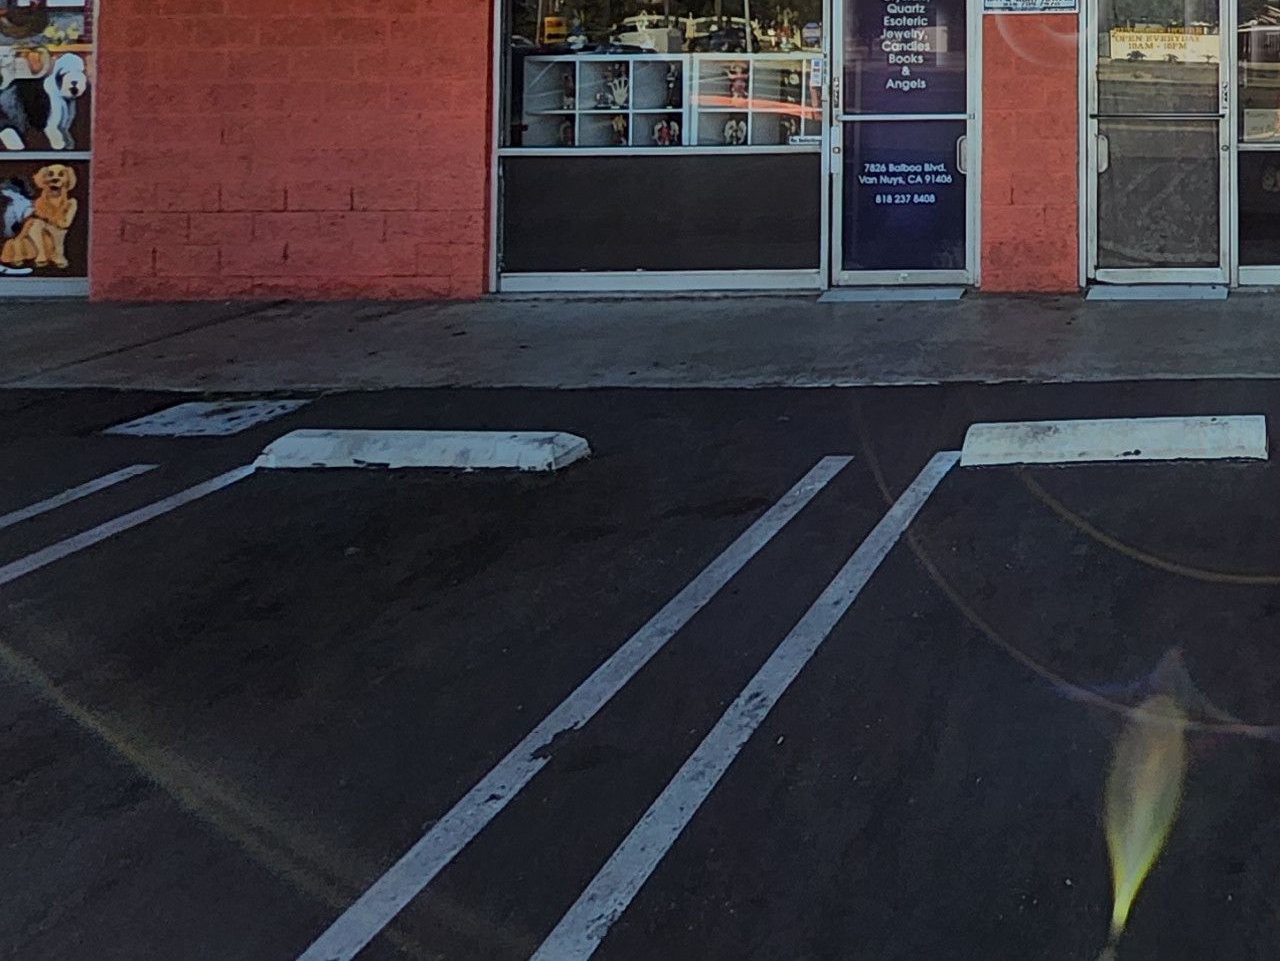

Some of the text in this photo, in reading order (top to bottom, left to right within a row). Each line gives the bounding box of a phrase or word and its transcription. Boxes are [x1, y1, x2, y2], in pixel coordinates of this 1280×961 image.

[886, 4, 925, 15] Quartz
[883, 16, 929, 26] Esoteric
[880, 28, 928, 40] Jewelry,
[881, 40, 930, 52] Candles
[888, 54, 924, 64] Books
[901, 66, 910, 76] &
[886, 79, 927, 91] Angels
[864, 163, 947, 173] 7826 Balboa Blvd.
[858, 175, 877, 184] Van
[907, 175, 923, 184] CA
[924, 174, 953, 184] 91406
[875, 194, 893, 203] 818
[894, 194, 911, 203] 237
